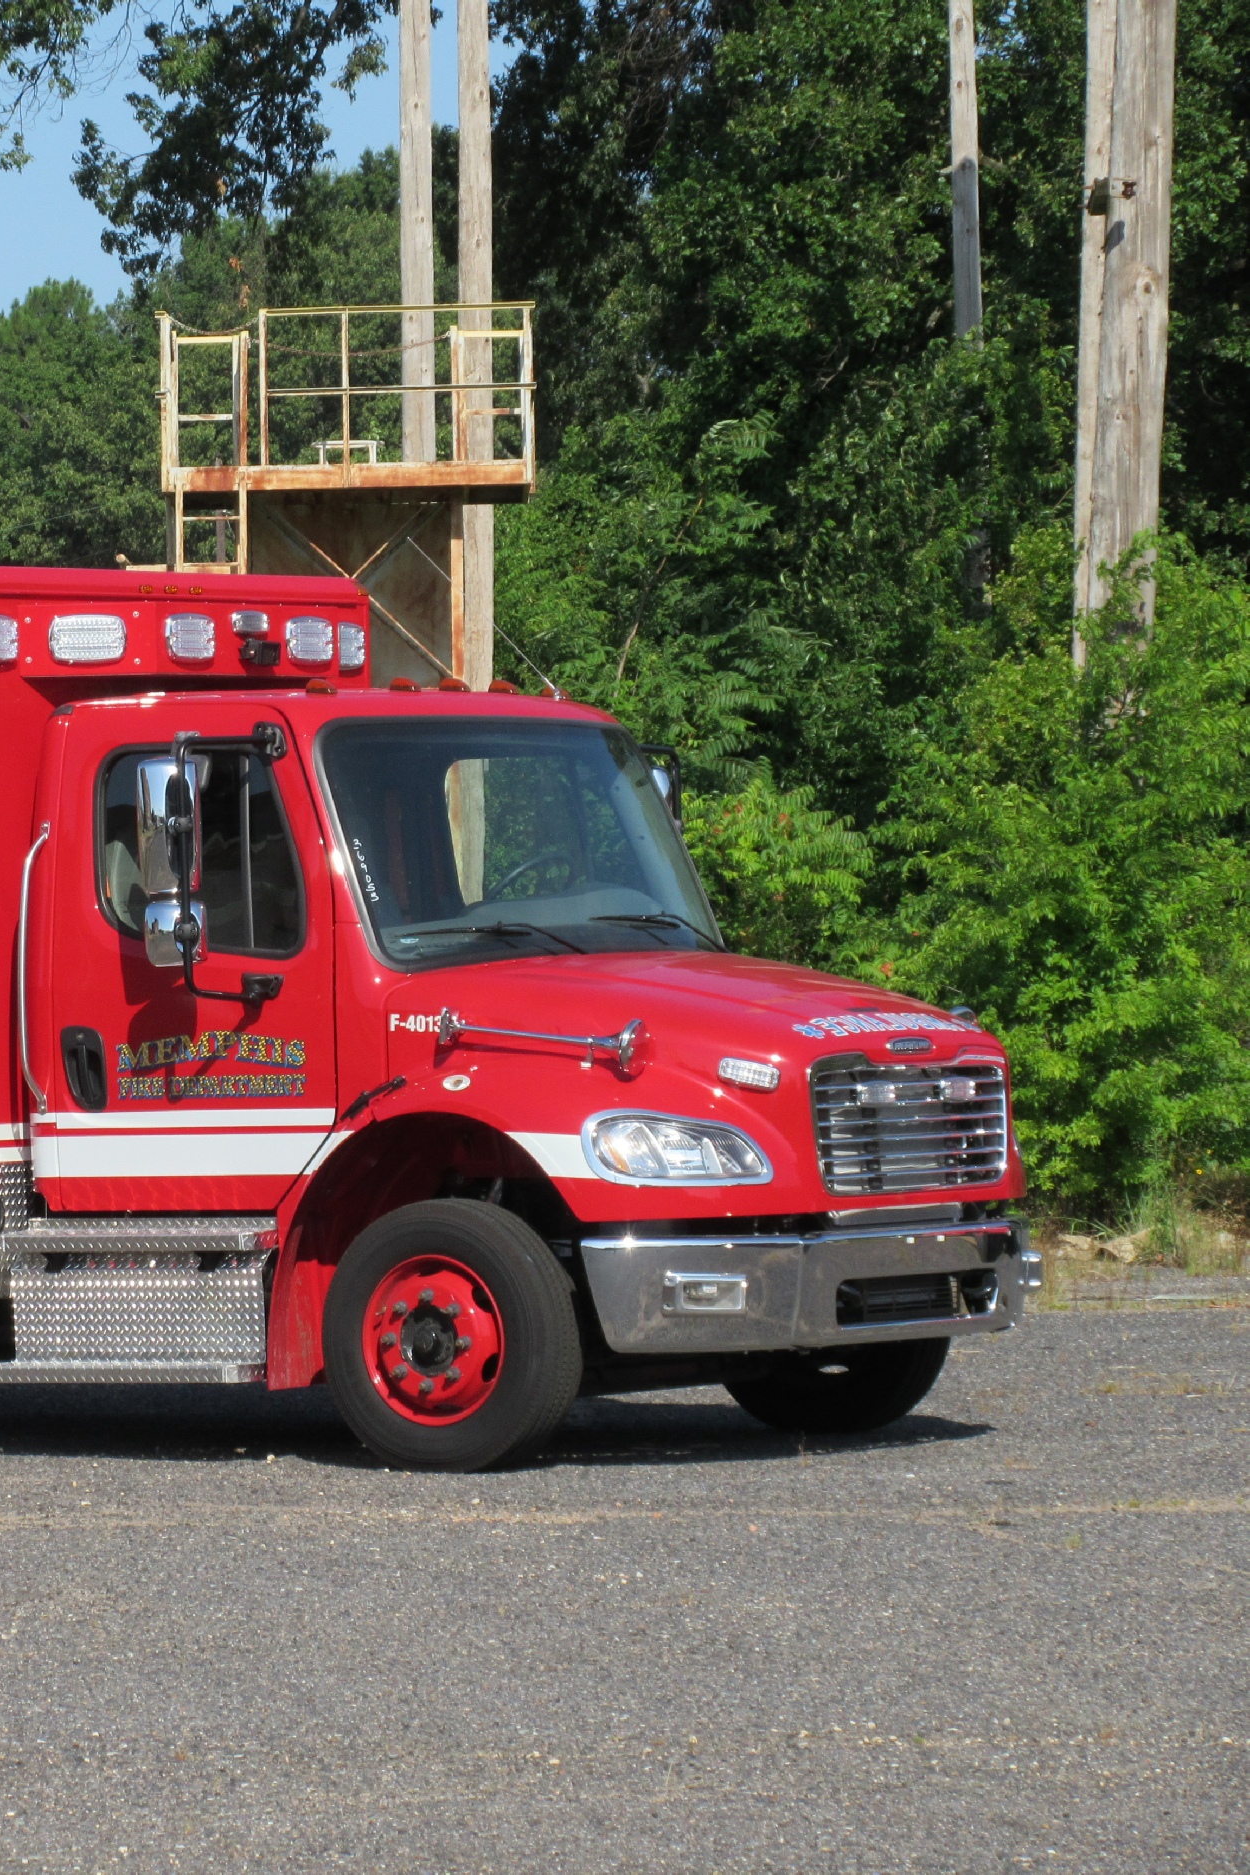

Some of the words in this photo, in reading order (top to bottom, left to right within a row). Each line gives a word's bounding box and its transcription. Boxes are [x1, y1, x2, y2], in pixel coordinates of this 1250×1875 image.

[116, 1030, 307, 1072] MEMPHIS
[118, 1076, 166, 1099] FIRE
[169, 1073, 307, 1100] DEPARTMENT
